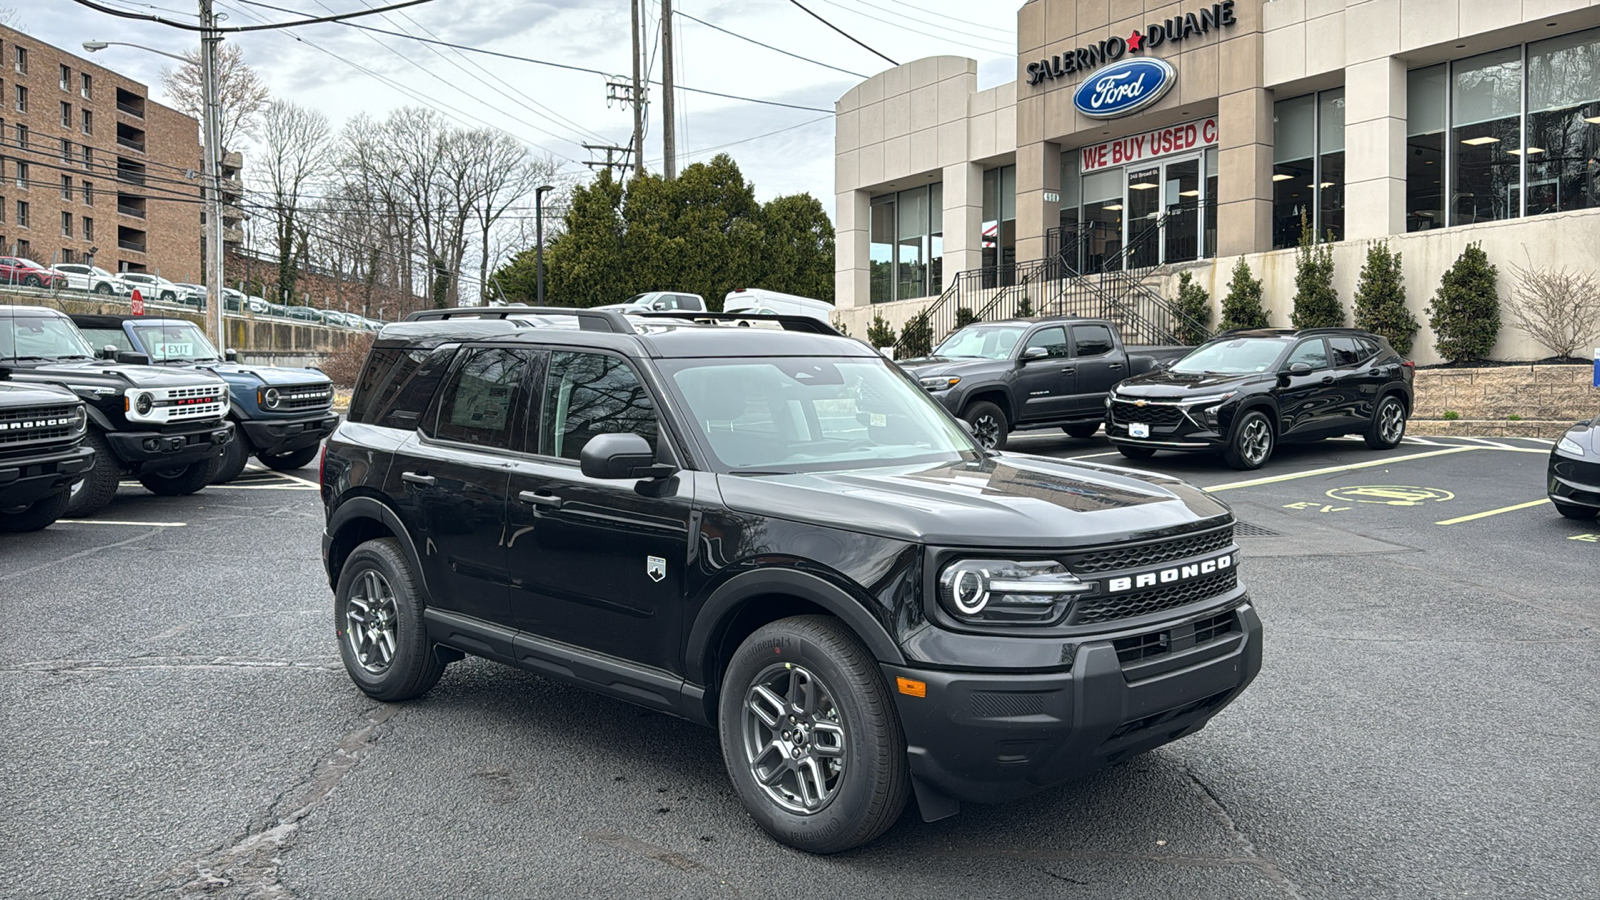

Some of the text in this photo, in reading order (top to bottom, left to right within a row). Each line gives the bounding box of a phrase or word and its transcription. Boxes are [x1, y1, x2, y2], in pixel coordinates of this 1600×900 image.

[1026, 0, 1236, 86] SALERNO DUANE
[1091, 71, 1146, 109] Ford
[1083, 144, 1107, 170] WE
[1112, 135, 1146, 164] BUY
[1150, 124, 1197, 155] USED
[131, 300, 144, 313] STOP
[168, 344, 189, 354] EXIT
[178, 397, 212, 405] FORD
[0, 418, 68, 430] BRONCO
[1109, 555, 1231, 592] BRONCO
[740, 636, 785, 666] Continental
